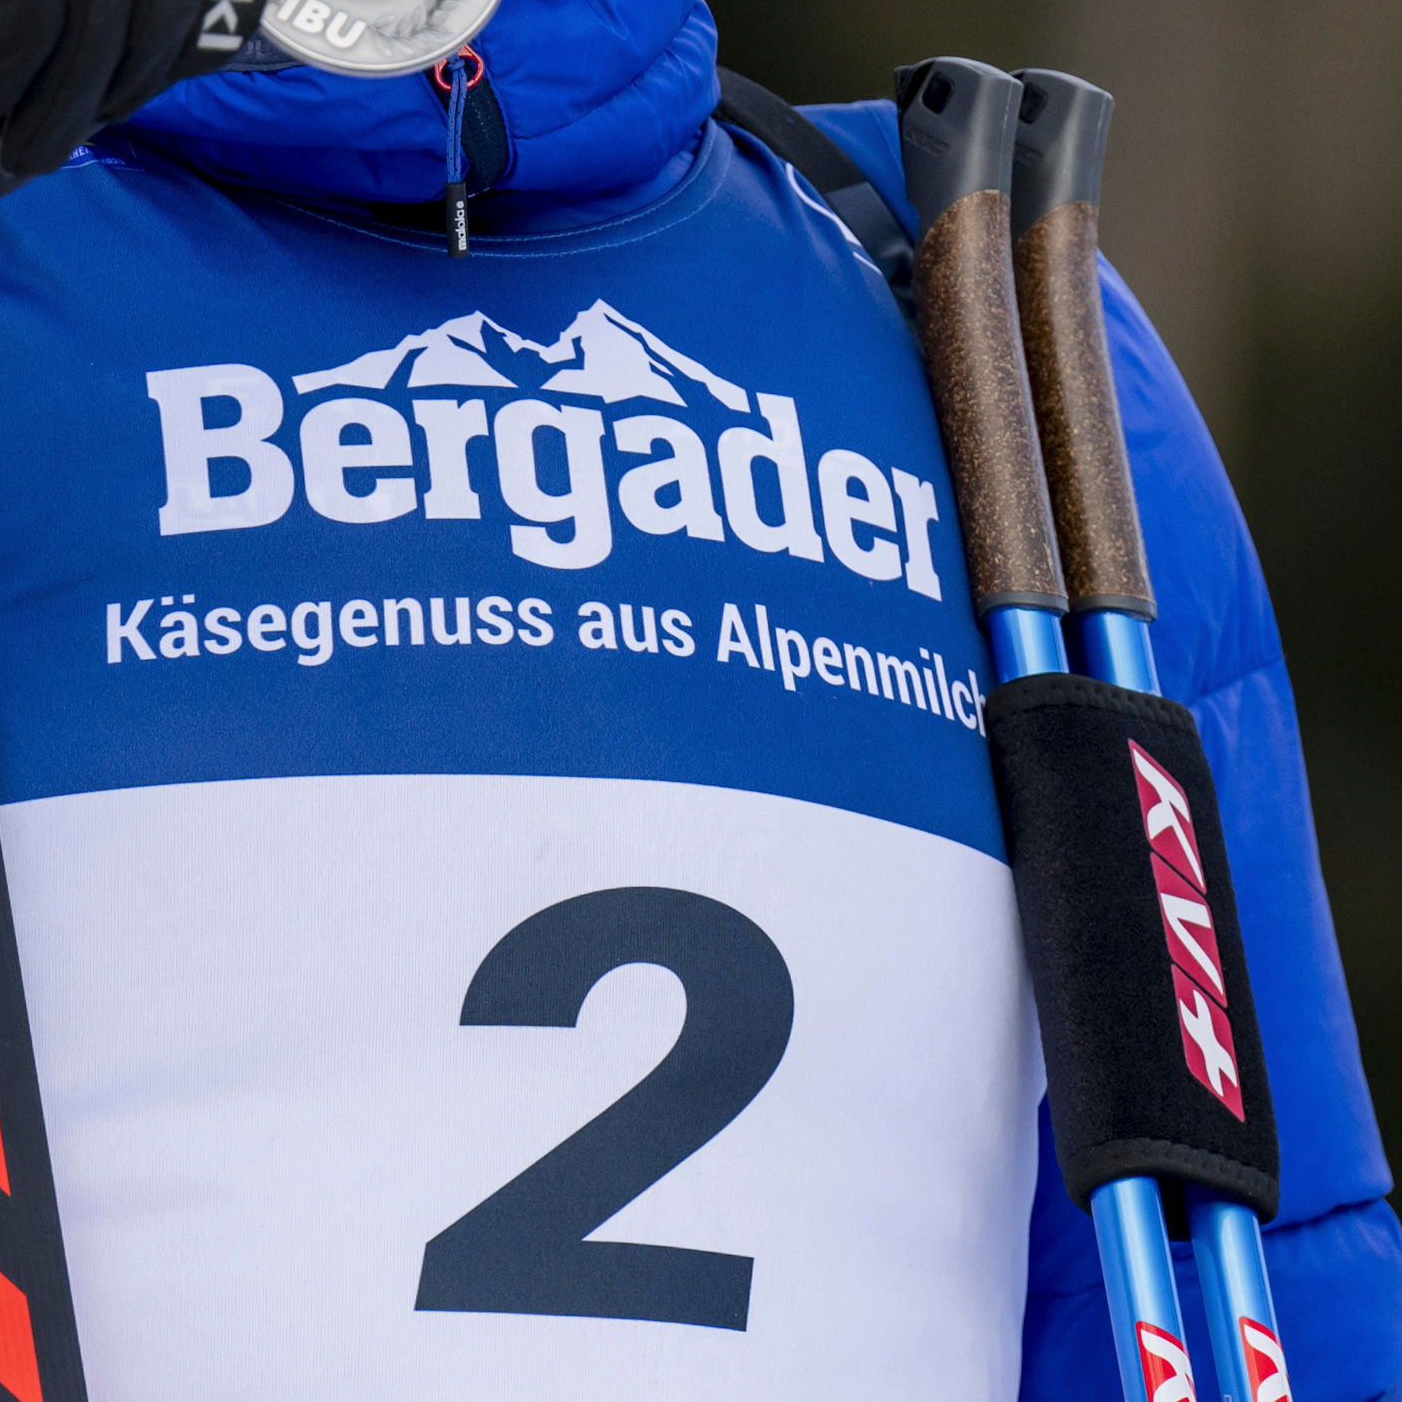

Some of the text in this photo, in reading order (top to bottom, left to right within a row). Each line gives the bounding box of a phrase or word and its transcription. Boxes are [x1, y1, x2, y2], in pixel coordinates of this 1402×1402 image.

[146, 363, 943, 601] Bergader
[105, 594, 554, 667] Käsegenuss
[577, 601, 697, 658] aus
[413, 885, 795, 1332] 2
